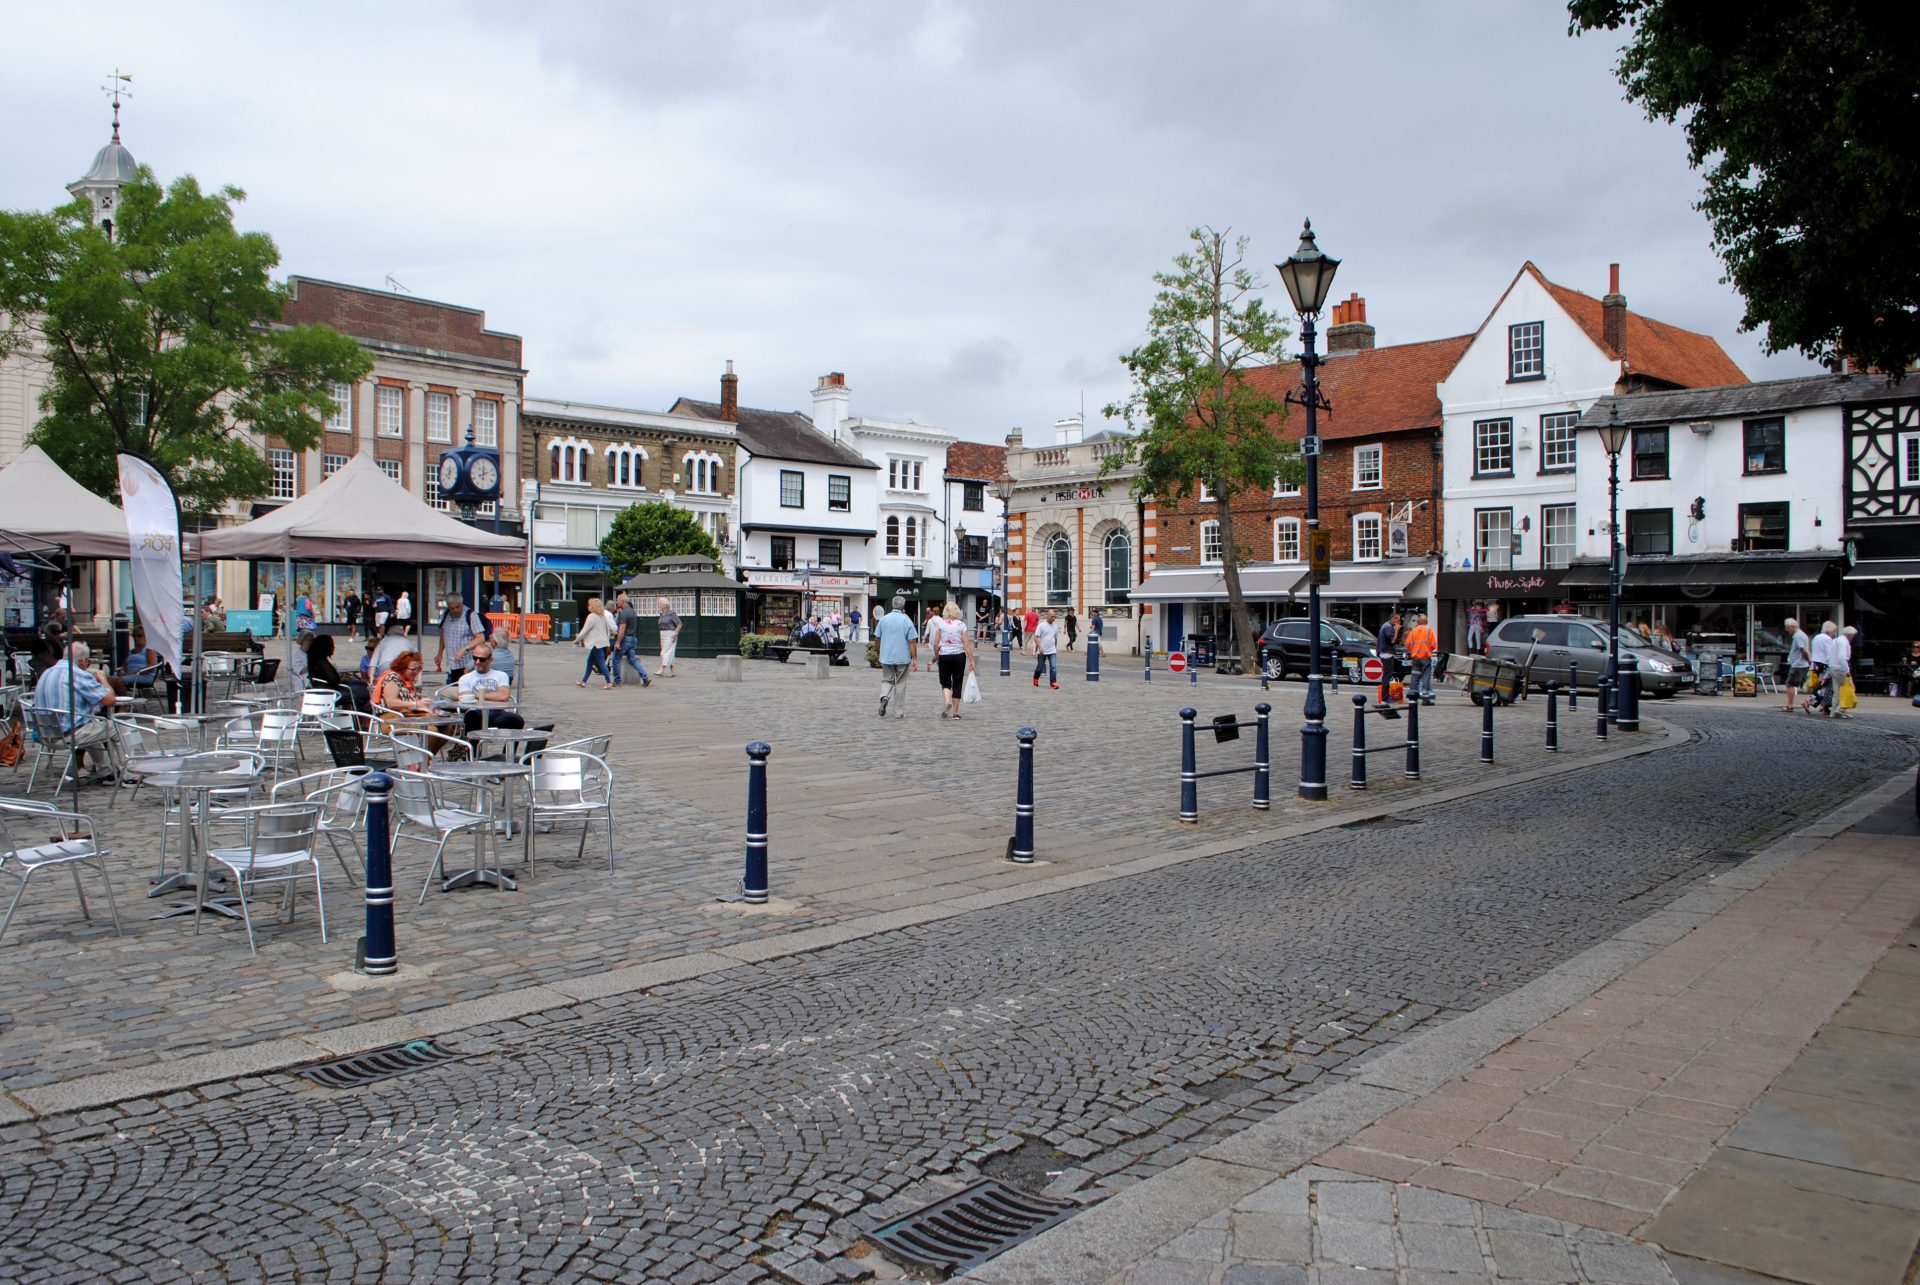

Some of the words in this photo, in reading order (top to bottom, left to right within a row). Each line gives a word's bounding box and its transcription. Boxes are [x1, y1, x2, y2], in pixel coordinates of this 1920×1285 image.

[1056, 490, 1077, 502] HSBC
[1091, 489, 1104, 498] UK
[755, 574, 796, 583] MERRIC
